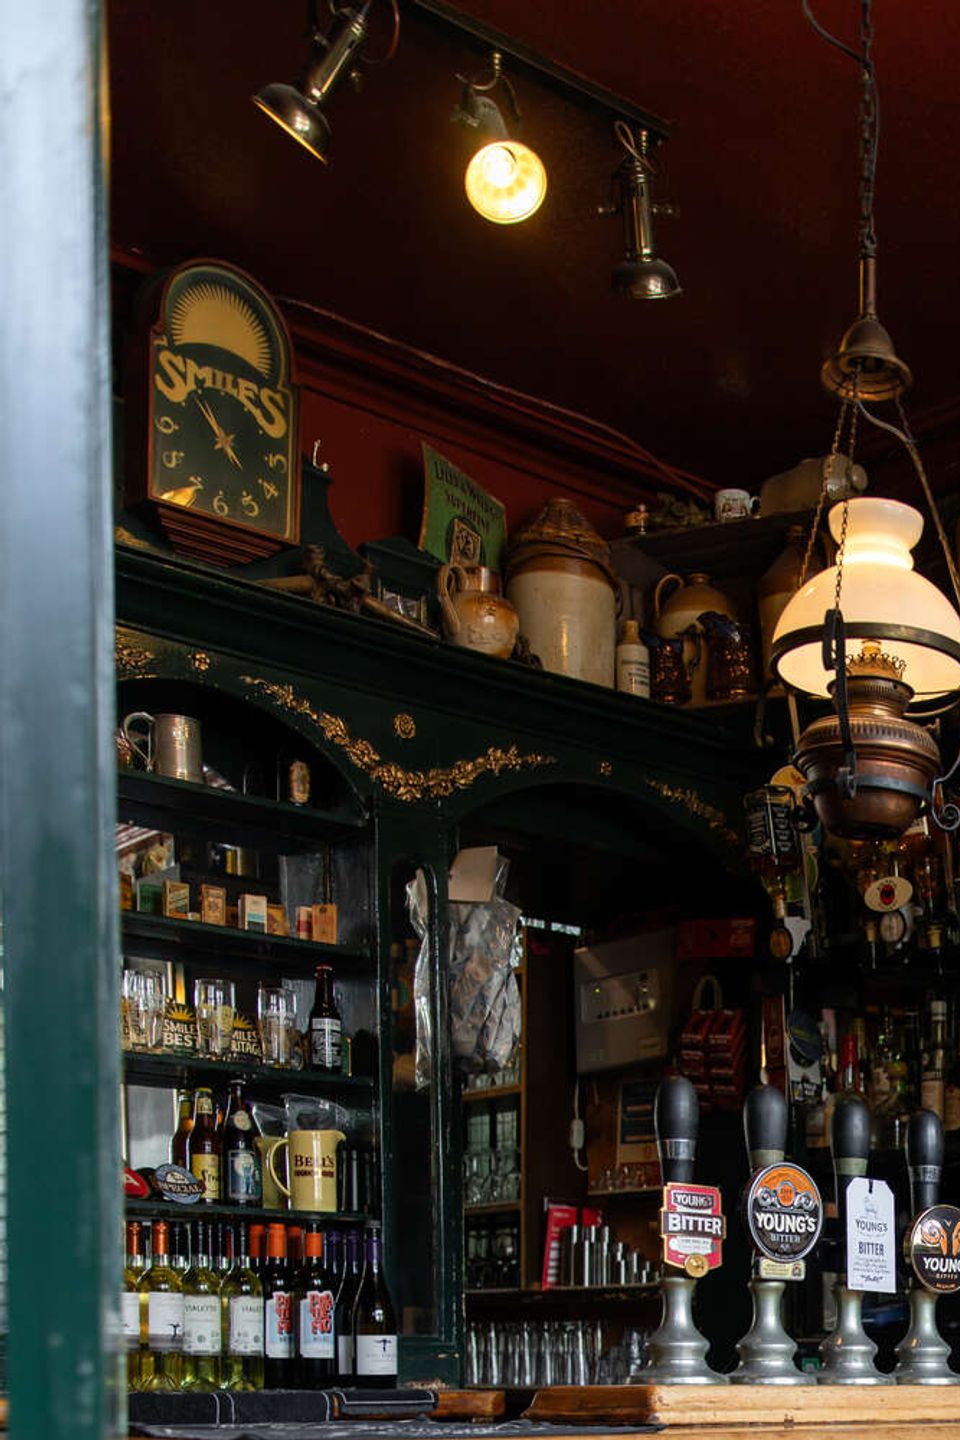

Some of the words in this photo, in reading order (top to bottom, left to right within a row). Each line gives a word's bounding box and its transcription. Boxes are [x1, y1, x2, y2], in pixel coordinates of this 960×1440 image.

[155, 350, 288, 440] SMILES
[262, 481, 280, 499] 4
[213, 495, 229, 516] 6
[242, 495, 260, 518] 5
[231, 1030, 258, 1042] MILES
[668, 1212, 722, 1237] BITTER
[755, 1212, 818, 1234] YOUNG'S
[855, 1219, 888, 1233] YOUNG'S
[770, 1233, 801, 1243] BITTER
[858, 1241, 884, 1256] BITTER
